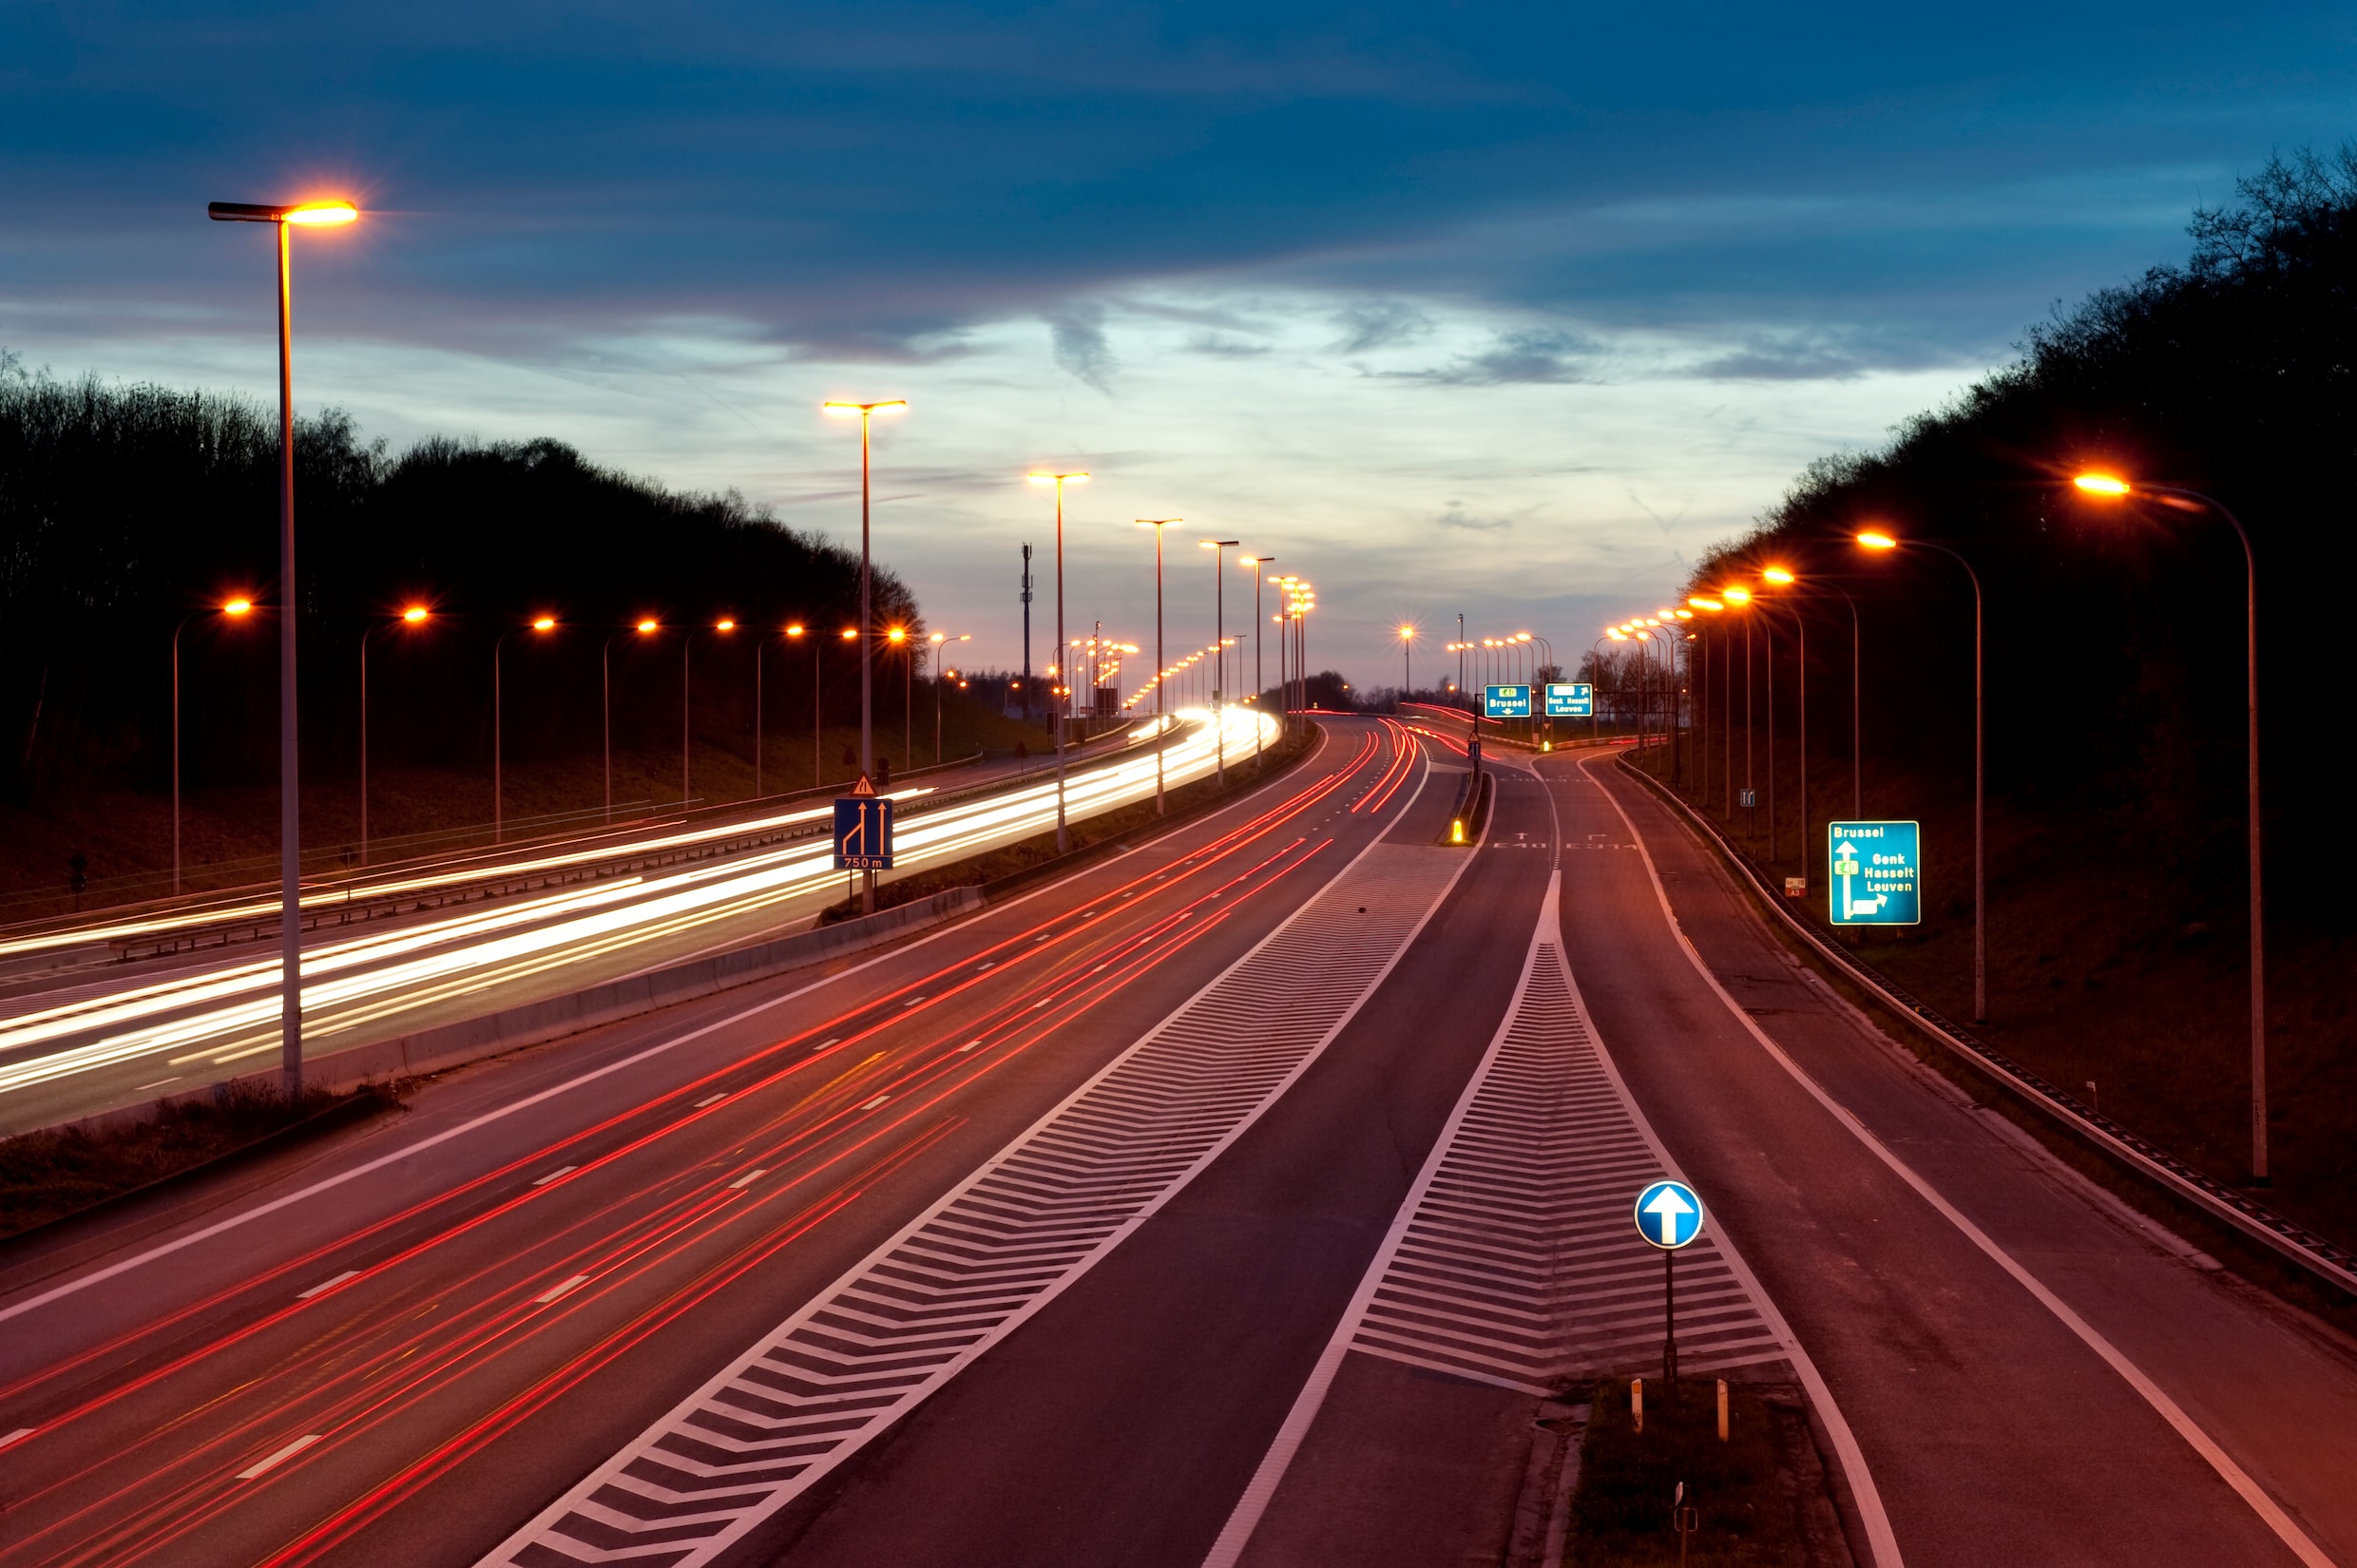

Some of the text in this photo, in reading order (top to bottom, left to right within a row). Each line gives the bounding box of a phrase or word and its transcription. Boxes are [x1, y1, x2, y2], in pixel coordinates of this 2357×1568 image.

[1489, 698, 1526, 707] Brussel
[1834, 827, 1884, 838] Brussel
[844, 857, 883, 868] 750 m
[1872, 852, 1906, 865] Genk
[1865, 867, 1914, 878] Hasselt
[1867, 880, 1912, 891] Leuven
